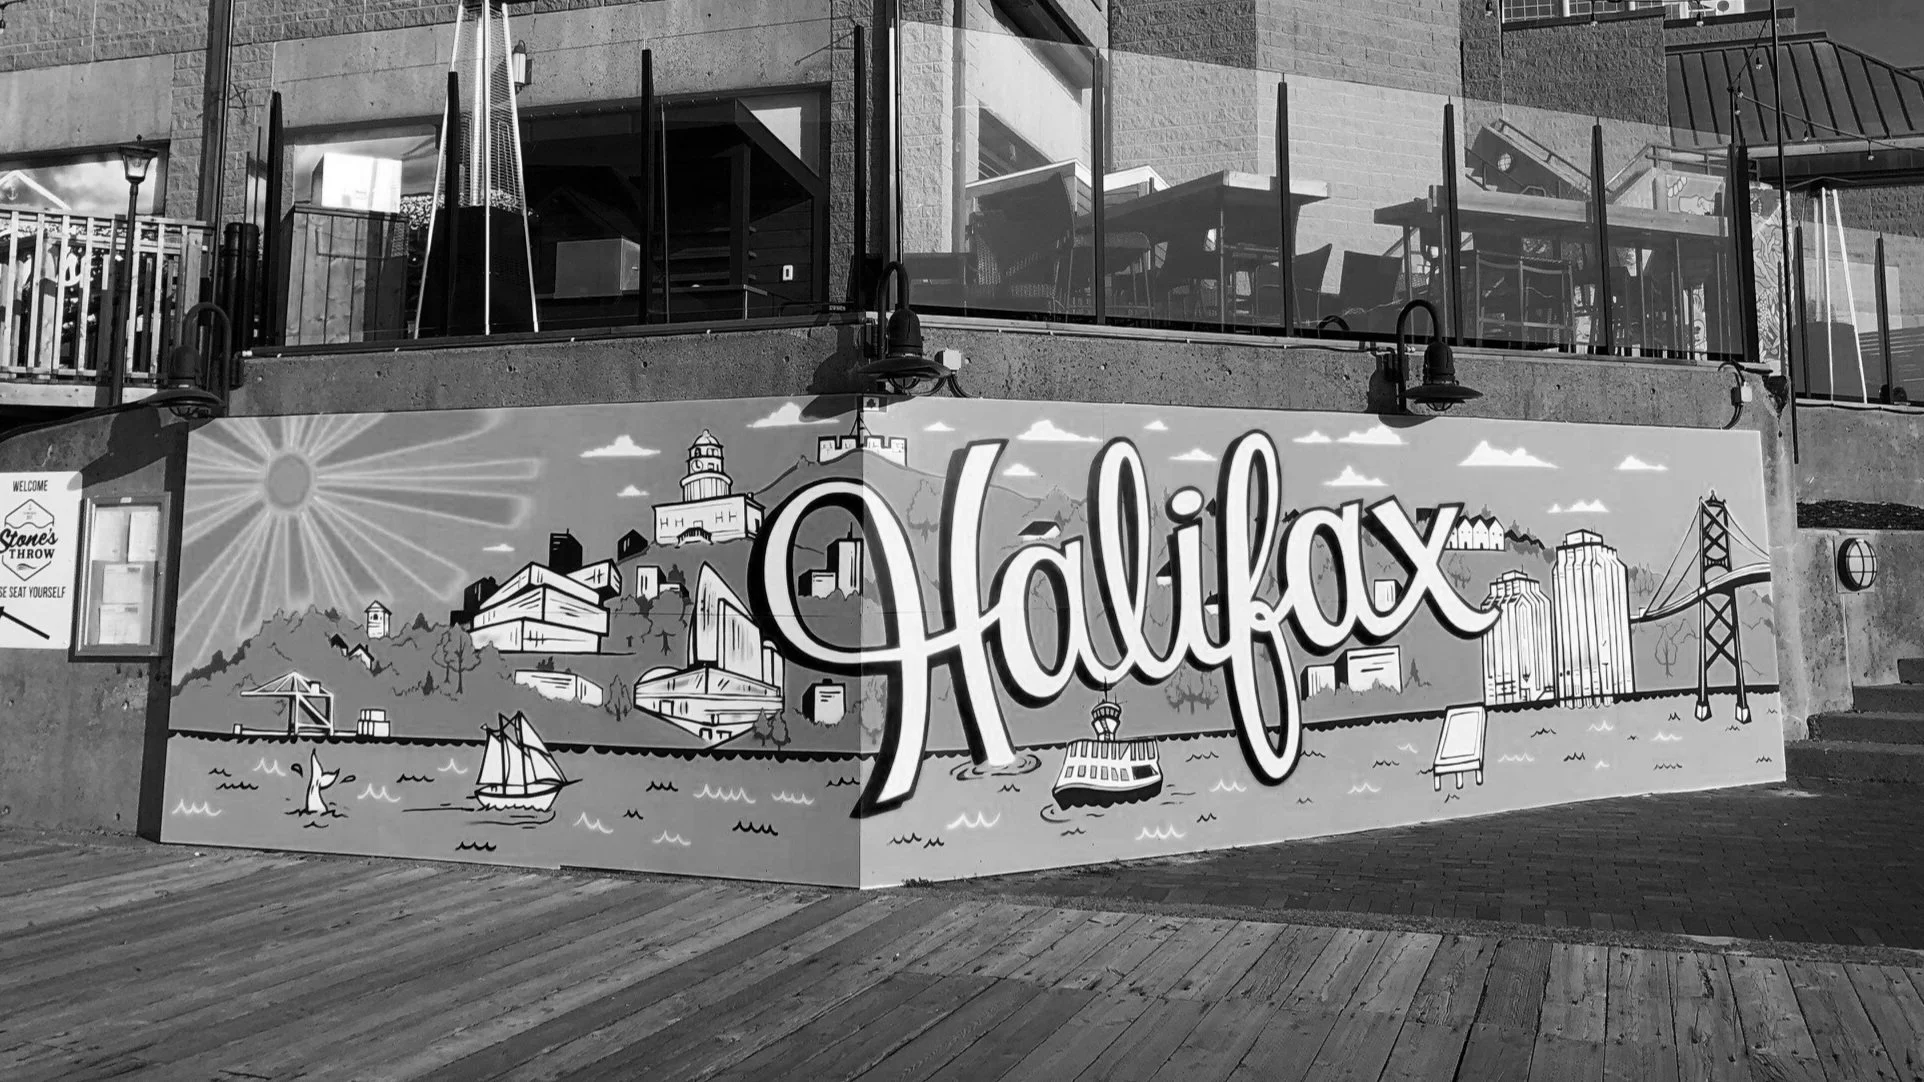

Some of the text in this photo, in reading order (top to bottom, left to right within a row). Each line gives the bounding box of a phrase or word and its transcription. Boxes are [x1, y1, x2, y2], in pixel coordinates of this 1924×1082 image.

[13, 479, 48, 492] WELCOME
[0, 527, 59, 554] Stone's
[9, 548, 55, 559] THROW
[9, 586, 27, 598] SEAT
[29, 586, 66, 598] YOURSELF
[748, 428, 1503, 818] Halifax
